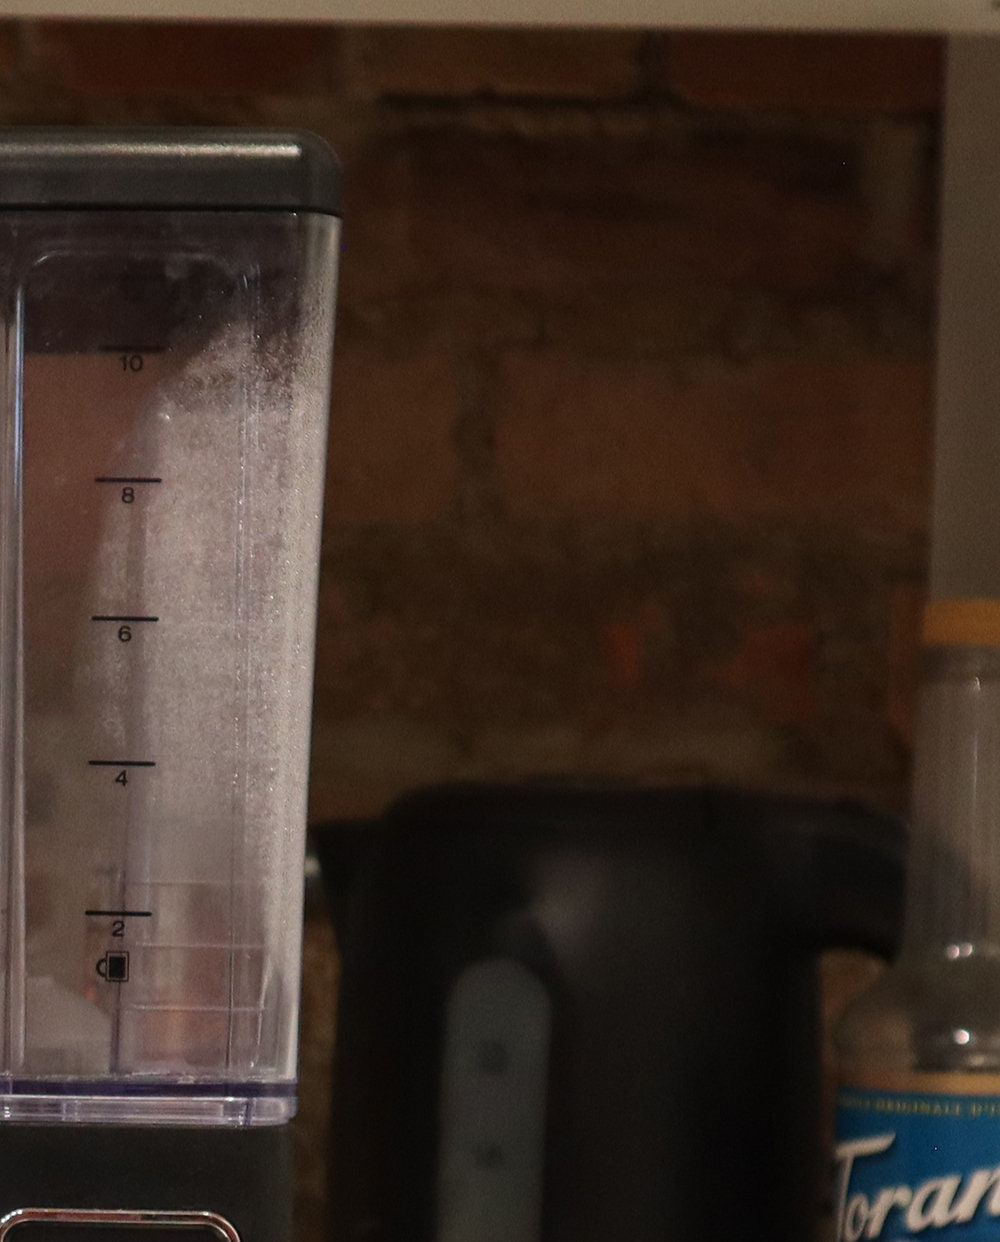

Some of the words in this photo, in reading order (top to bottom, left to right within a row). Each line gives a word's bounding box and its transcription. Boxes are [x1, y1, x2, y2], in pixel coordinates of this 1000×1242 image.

[120, 354, 143, 372] 10
[122, 487, 135, 504] 8
[118, 625, 132, 642] 6
[115, 770, 128, 787] 4
[112, 920, 125, 937] 2
